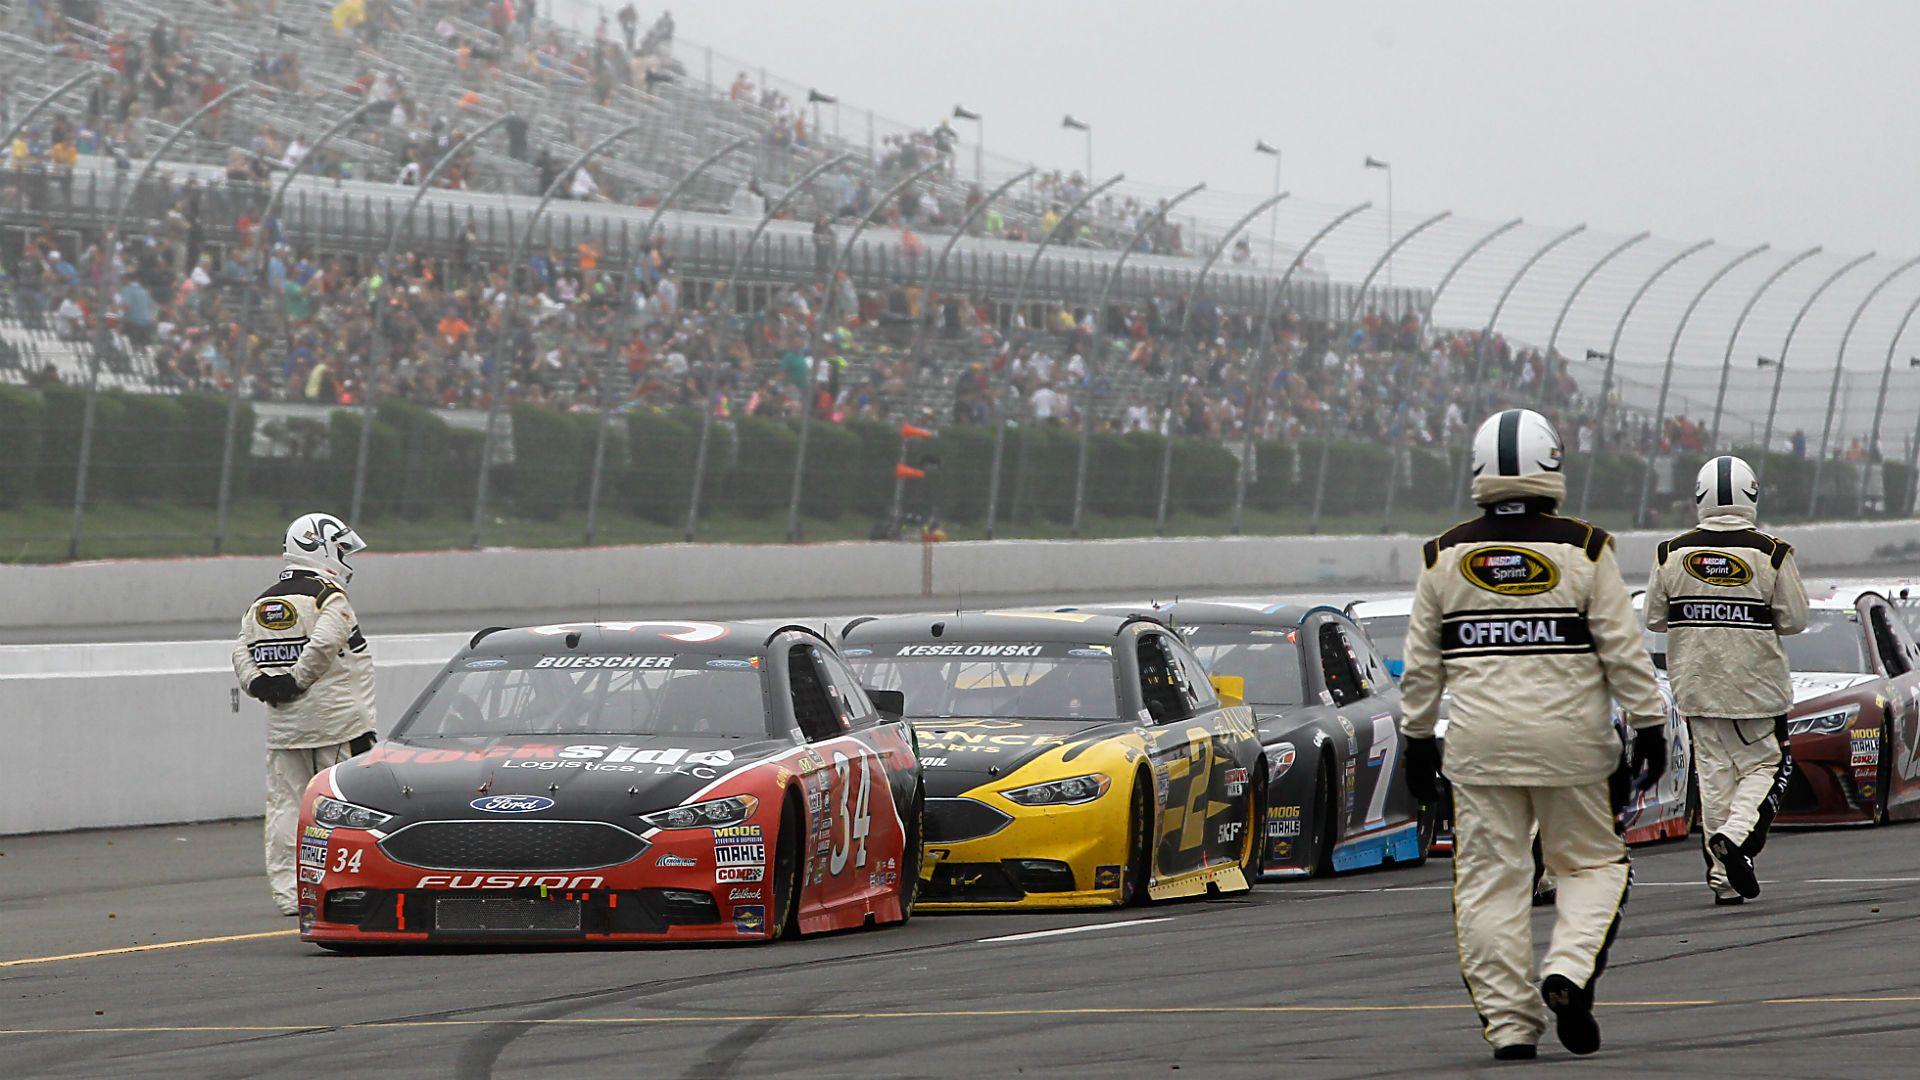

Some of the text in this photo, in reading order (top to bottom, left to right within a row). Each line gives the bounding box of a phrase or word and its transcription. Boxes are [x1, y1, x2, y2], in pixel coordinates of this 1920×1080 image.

[1488, 555, 1522, 566] NASCAR
[1493, 567, 1527, 581] Sprint
[1705, 565, 1729, 575] Sprint
[1683, 603, 1754, 622] OFFICIAL
[1458, 620, 1566, 646] OFFICIAL
[254, 645, 303, 662] OFFICIA
[896, 645, 1043, 657] KESELOWSKI
[533, 656, 675, 669] BUESCHER
[1850, 727, 1880, 740] MOOG
[654, 765, 718, 780] LLC
[1363, 712, 1399, 830] 7
[485, 796, 540, 811] Ford
[830, 748, 871, 877] 34
[1267, 806, 1301, 818] MOOG
[713, 825, 761, 838] MOOG
[1217, 822, 1243, 844] SKF
[1268, 820, 1301, 834] MAHLE
[332, 847, 364, 874] 34
[715, 845, 765, 863] MAHLE
[416, 875, 604, 889] FUSION
